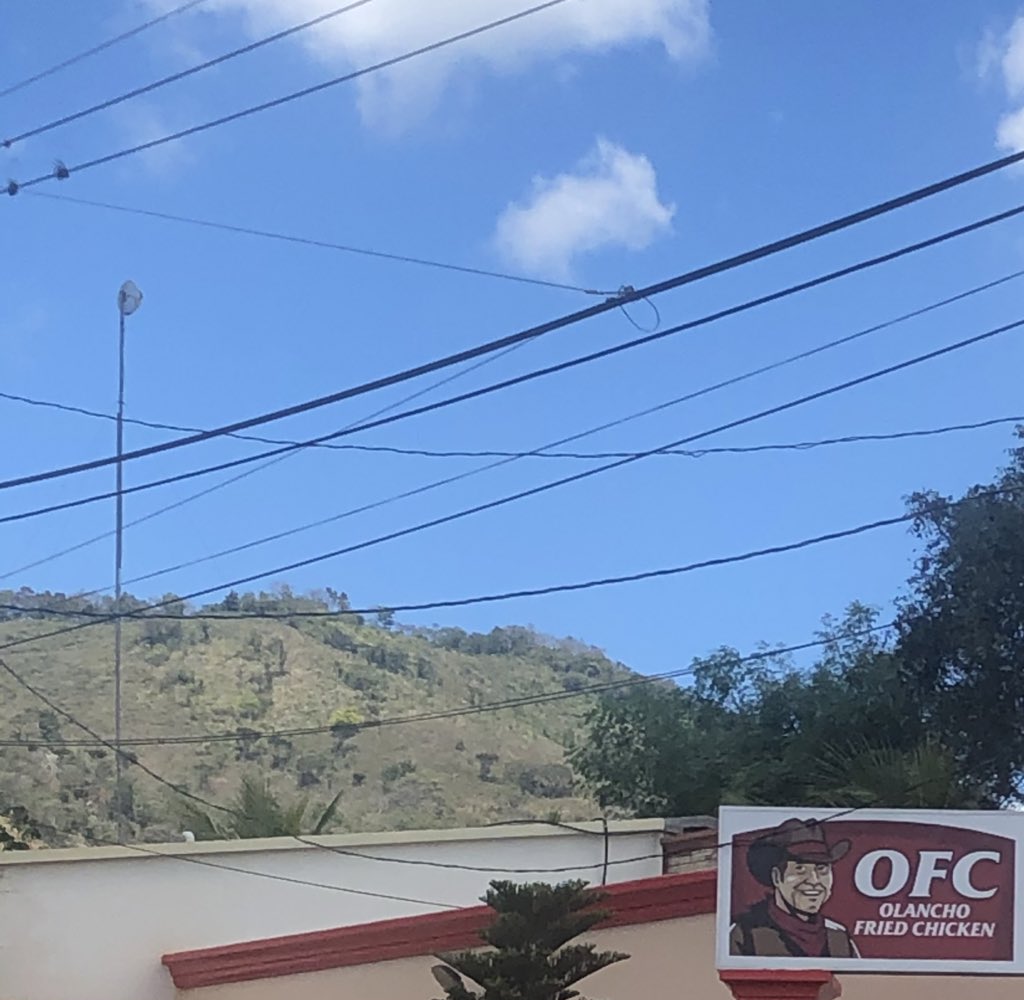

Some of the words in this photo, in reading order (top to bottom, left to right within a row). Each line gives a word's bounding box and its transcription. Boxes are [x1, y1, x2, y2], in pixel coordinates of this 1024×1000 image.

[854, 849, 1001, 899] OFC
[879, 902, 971, 919] OLANCHO
[853, 920, 909, 936] FRIED
[911, 921, 996, 938] CHICKEN
